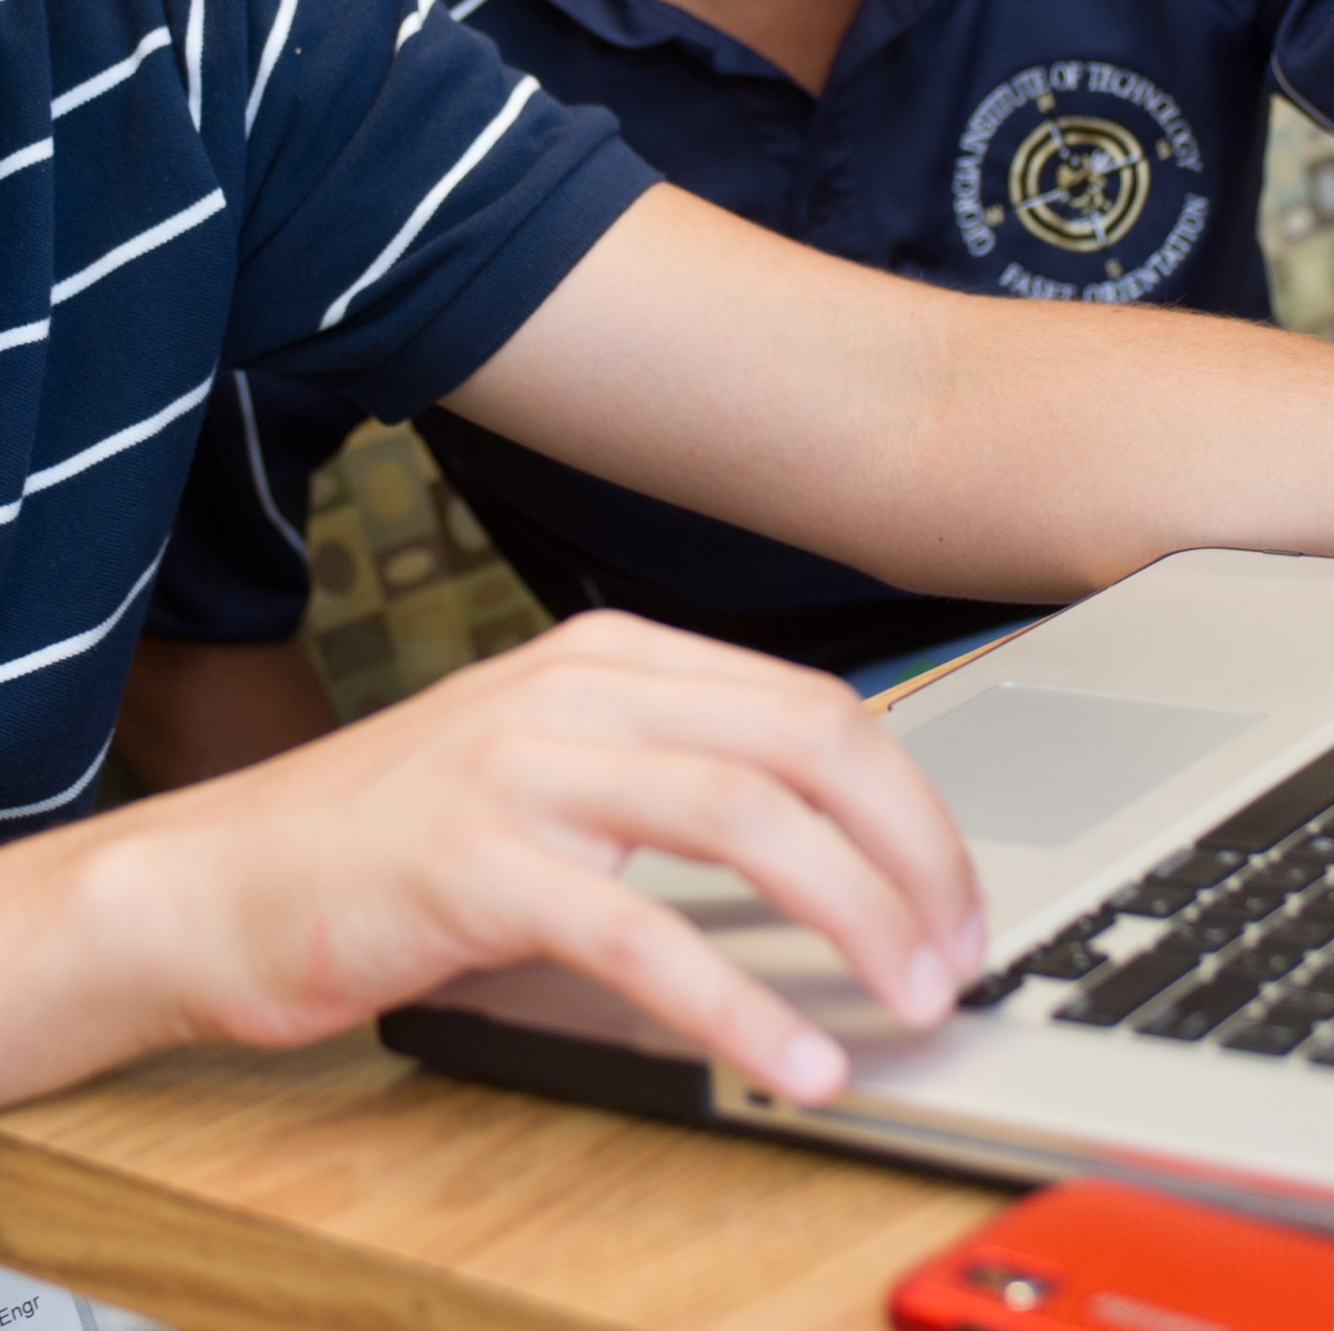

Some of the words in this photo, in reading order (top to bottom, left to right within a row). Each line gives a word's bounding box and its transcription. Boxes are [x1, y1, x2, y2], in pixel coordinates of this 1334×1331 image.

[960, 66, 1050, 155] INSTITUTE
[1049, 60, 1084, 91] OF
[1085, 60, 1204, 172] TECHNOLOGY
[1082, 192, 1210, 303] ORIENTATION
